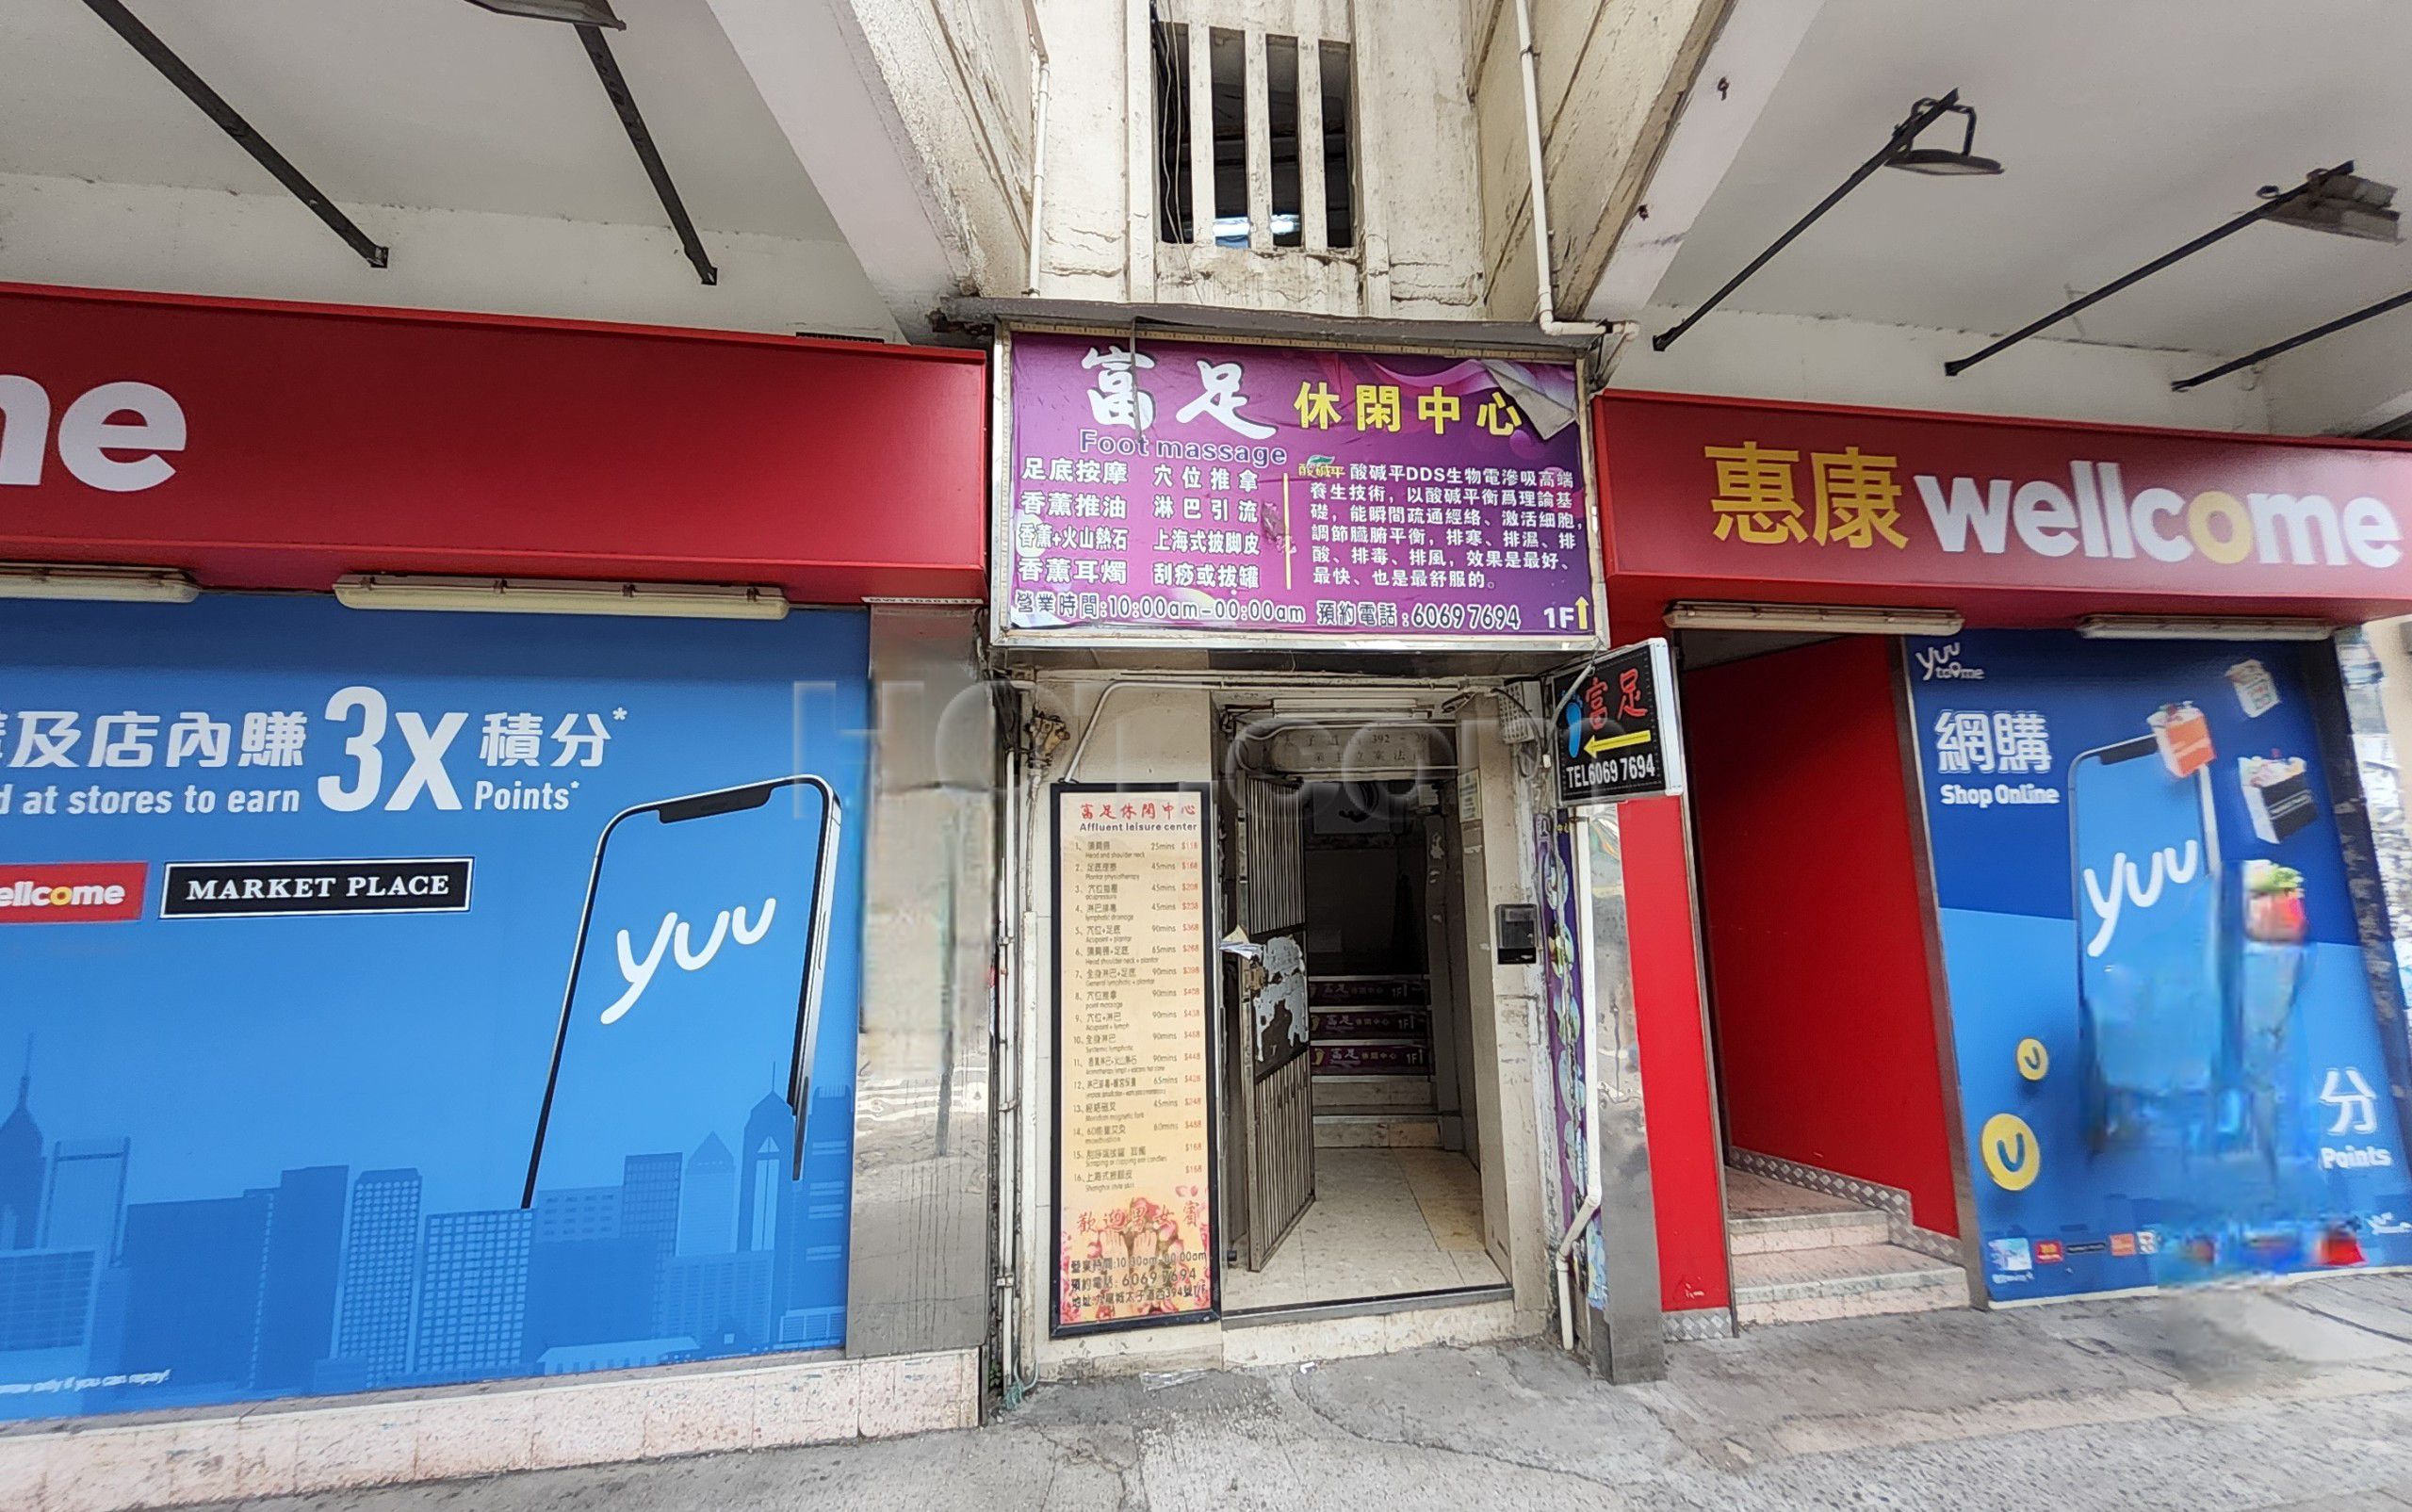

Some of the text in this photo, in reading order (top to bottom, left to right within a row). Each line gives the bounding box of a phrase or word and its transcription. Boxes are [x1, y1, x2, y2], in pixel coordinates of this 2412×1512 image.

[1079, 430, 1288, 468] Foot massage
[1021, 457, 1259, 493] 足底按摩 穴位推拿
[1019, 490, 1259, 524] 香薰推油 淋巴引流
[1704, 440, 2404, 567] 惠康 wellcome
[1018, 557, 1128, 585] 香薰耳燭
[1543, 607, 1575, 629] 1F
[1915, 642, 1961, 681] yuu
[1585, 668, 1648, 730] 富足
[0, 711, 308, 768] 及店內賺
[1934, 710, 2053, 773] 網購
[1620, 753, 1655, 781] 7694
[23, 785, 58, 815] at
[67, 786, 173, 814] stores
[185, 785, 217, 813] to
[227, 789, 301, 813] earn
[1941, 783, 2061, 808] Shop Online
[1080, 822, 1197, 832] Affluent leisure center
[186, 874, 450, 901] MARKET PLACE
[2083, 840, 2198, 957] yuu
[599, 896, 776, 1026] yuu
[2320, 1066, 2377, 1135] 分
[2321, 1145, 2392, 1169] Points
[1122, 1270, 1157, 1287] 6069
